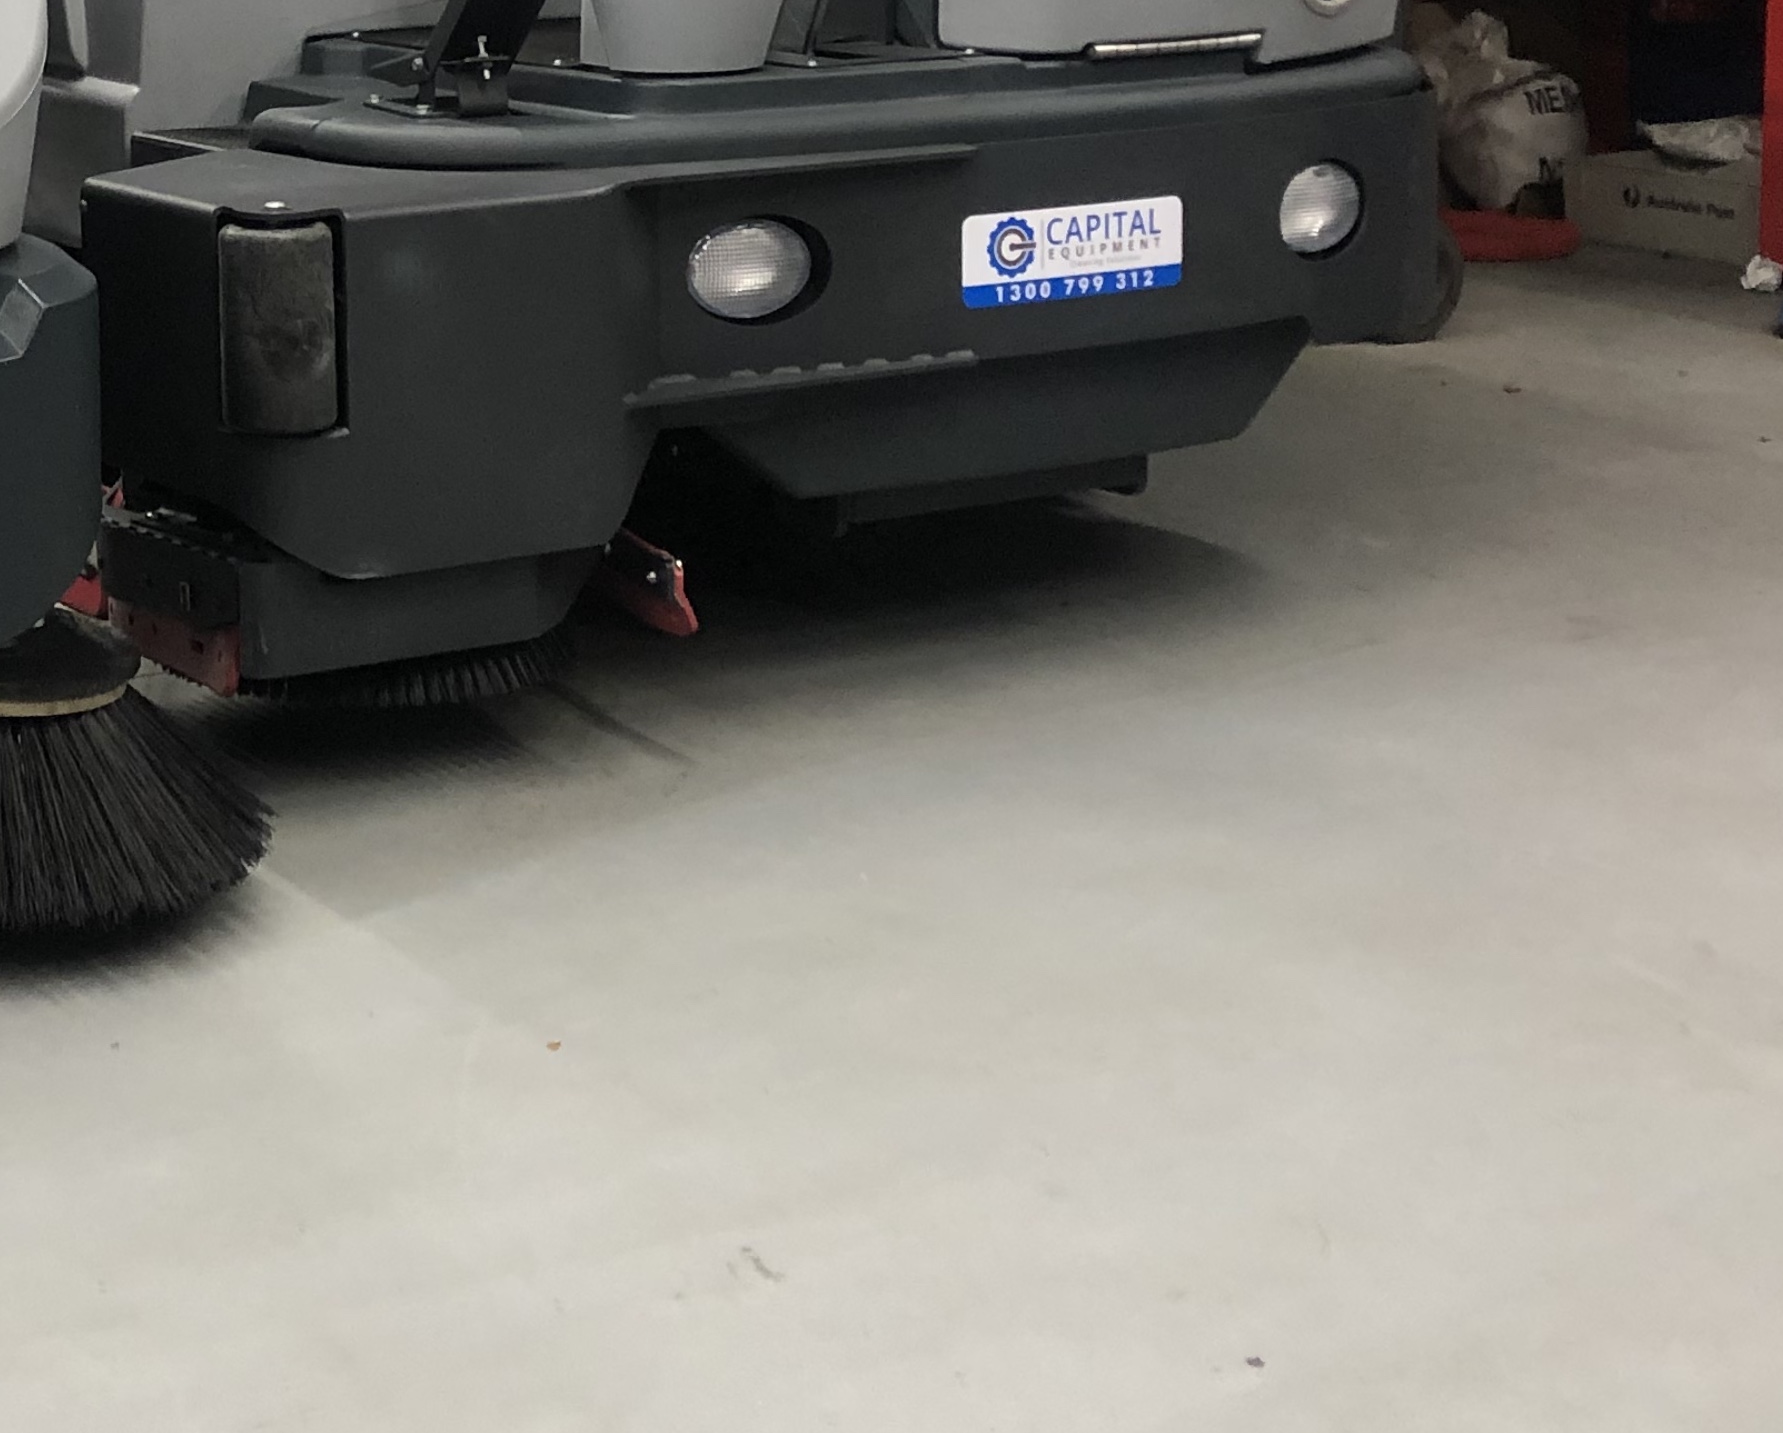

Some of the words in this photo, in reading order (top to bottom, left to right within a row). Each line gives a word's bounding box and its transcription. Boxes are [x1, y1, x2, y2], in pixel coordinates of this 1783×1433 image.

[1046, 208, 1162, 246] CAPITAL
[1048, 236, 1162, 261] EQUIPMENT
[995, 280, 1052, 304] 1300
[1064, 274, 1105, 297] 799
[1116, 269, 1155, 291] 312
